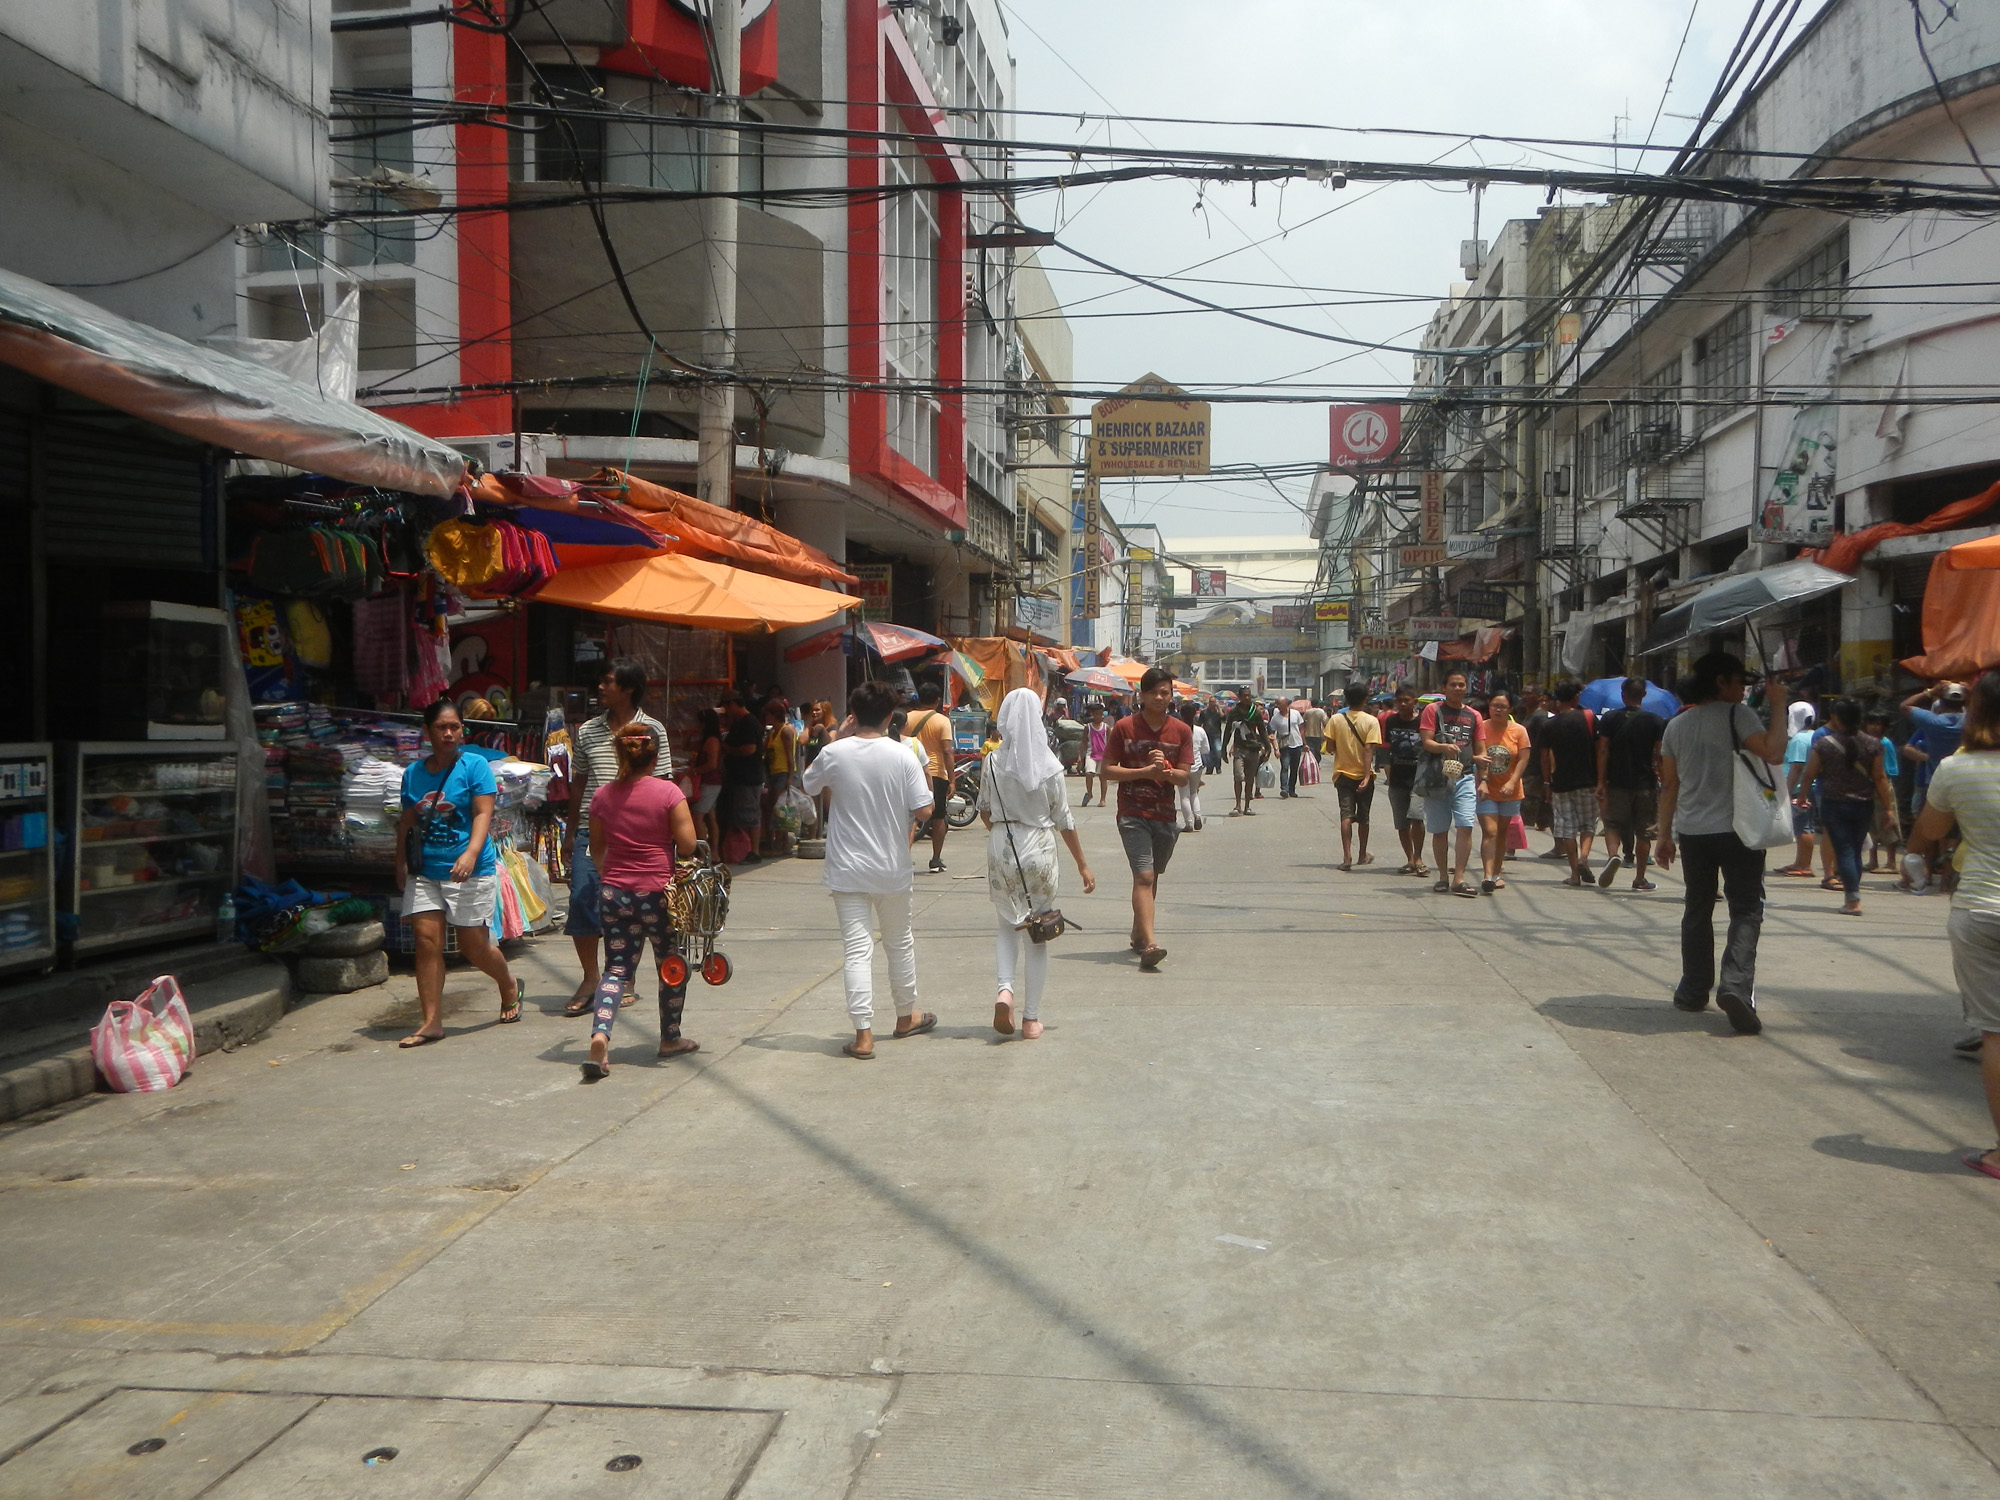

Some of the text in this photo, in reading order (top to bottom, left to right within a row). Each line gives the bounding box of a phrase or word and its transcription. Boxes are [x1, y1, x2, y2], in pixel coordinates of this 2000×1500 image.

[1096, 421, 1205, 437] HENRICK BAZAAR
[1098, 440, 1204, 457] & SUPERMARKET
[1158, 461, 1165, 469] &
[1427, 473, 1440, 541] PEREZ
[1448, 540, 1469, 552] MONEY
[1403, 548, 1447, 563] OPTIC
[1086, 542, 1098, 614] CENTER
[1412, 620, 1432, 630] TING
[1155, 641, 1180, 649] ALACE
